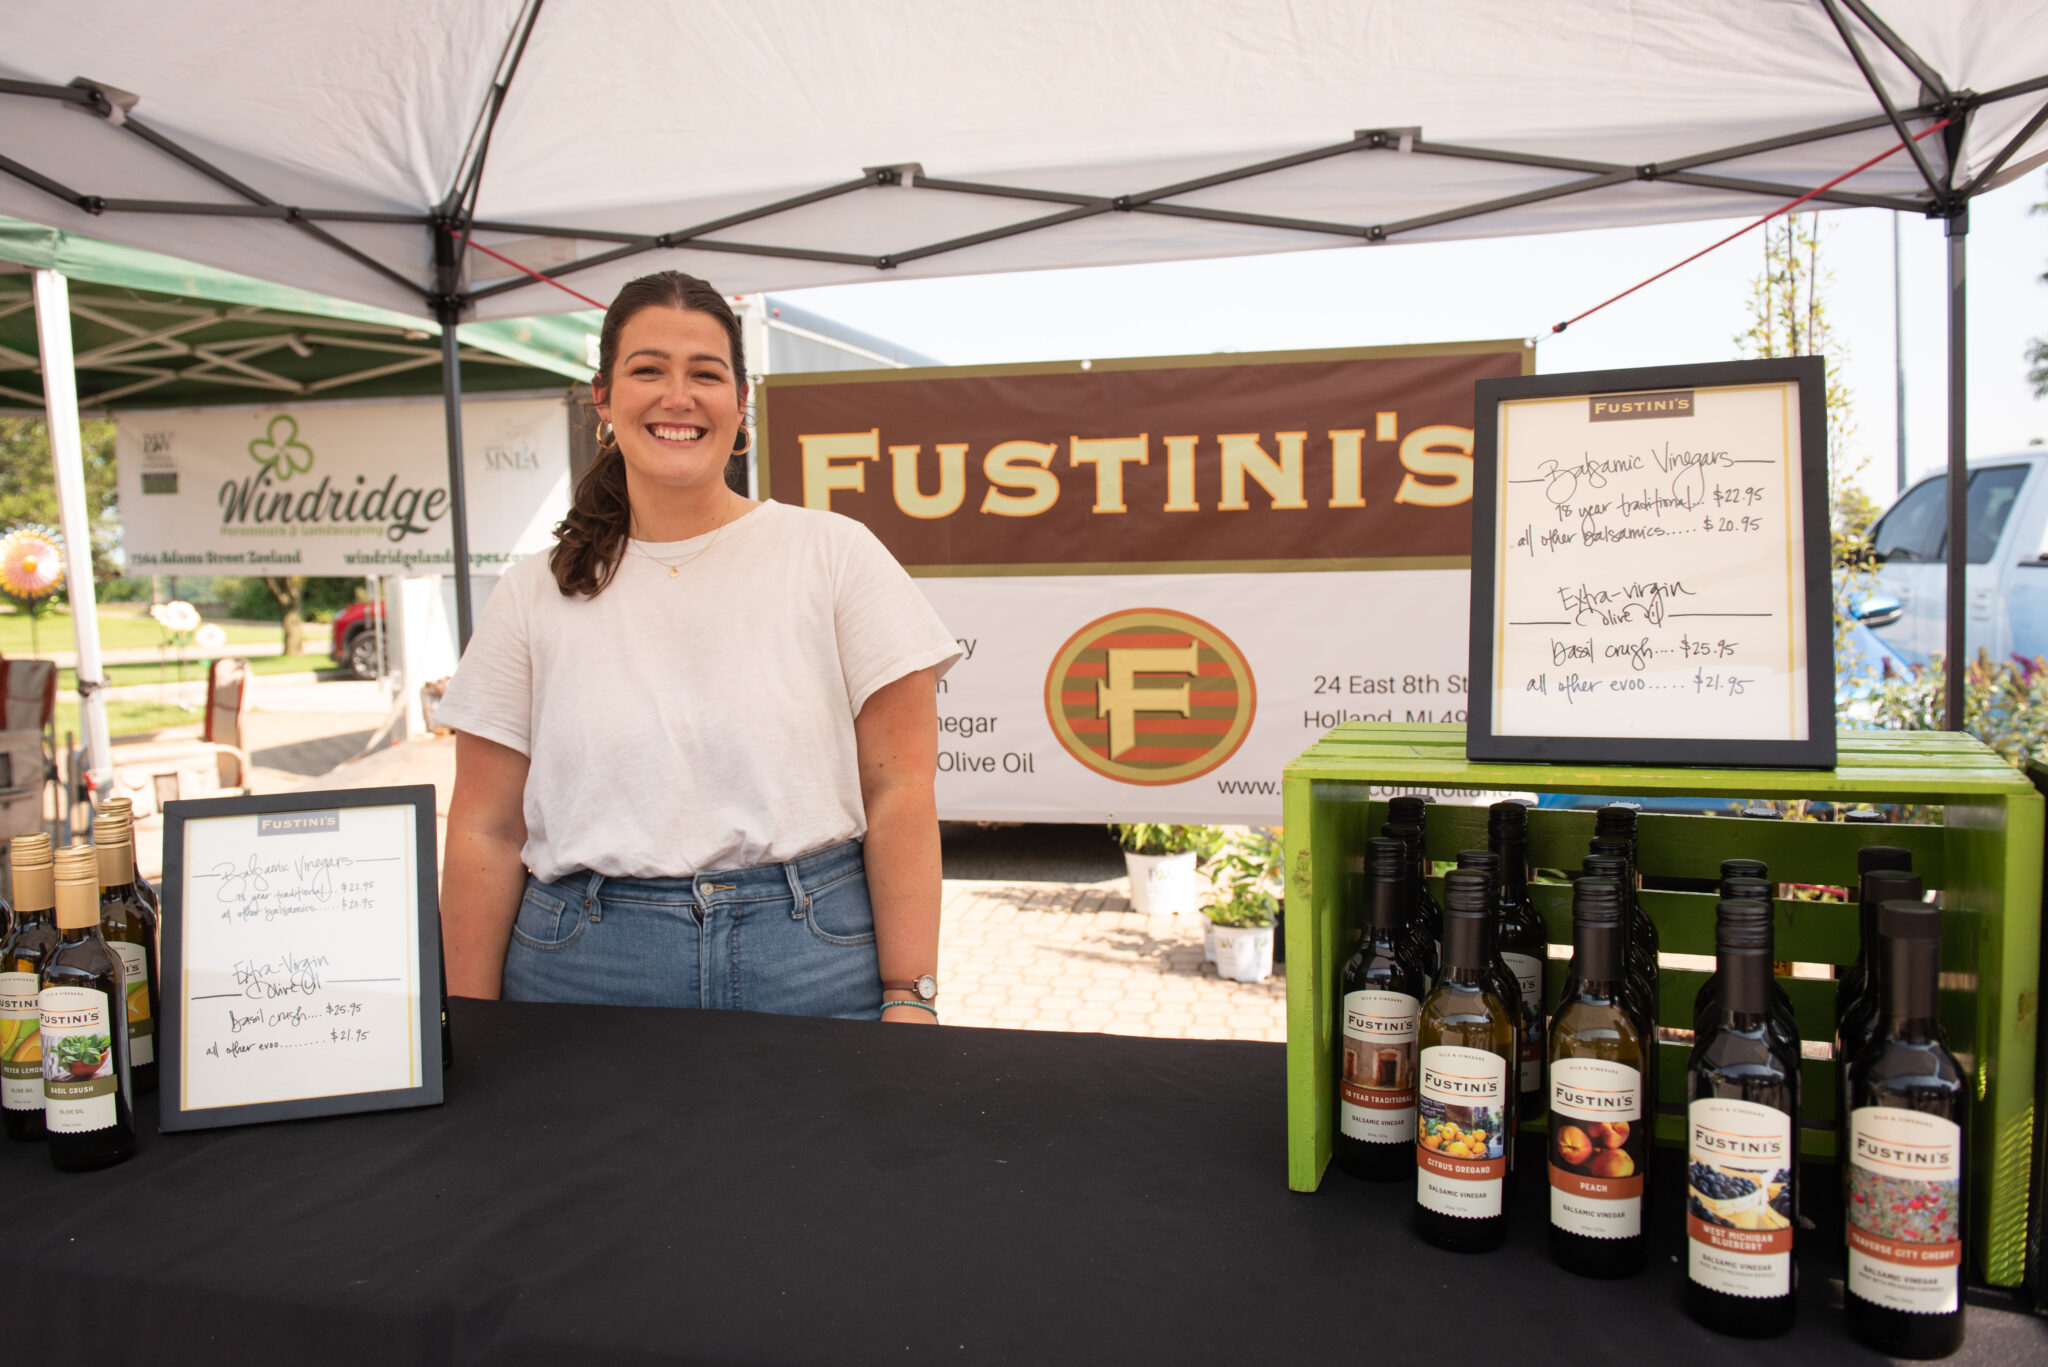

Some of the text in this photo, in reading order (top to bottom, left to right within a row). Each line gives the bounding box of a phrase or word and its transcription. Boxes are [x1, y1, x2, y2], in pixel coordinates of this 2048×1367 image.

[1593, 398, 1691, 415] FUSTINI'S
[797, 410, 1475, 519] FUSTINI'S
[1537, 441, 1735, 510] Balsamic Vinegars
[218, 463, 449, 541] Windridge
[1554, 504, 1573, 522] 18
[1578, 501, 1613, 534] year
[1713, 484, 1765, 508] $22.95
[1517, 524, 1534, 558] all
[1540, 528, 1578, 553] other
[159, 550, 202, 564] Adams
[204, 550, 244, 564] Street
[246, 549, 302, 564] Zeeland
[1679, 633, 1739, 659] $25.95
[1313, 675, 1342, 694] 24
[1349, 675, 1395, 694] East
[1402, 674, 1439, 694] 8th
[1526, 673, 1548, 696] all
[1557, 672, 1603, 705] other
[1692, 666, 1755, 697] $21.95
[1405, 710, 1432, 723] MI
[937, 751, 1035, 773] Olive Oil
[261, 816, 337, 831] FUSTINI'S
[211, 853, 354, 902] Balsamic Vinegars
[0, 999, 38, 1008] USTINI
[326, 1002, 363, 1016] $25.95
[40, 1012, 100, 1025] FUSTINI'S
[1347, 1014, 1414, 1032] FUSTINI'S
[206, 1041, 219, 1058] all
[226, 1040, 255, 1058] other
[330, 1027, 371, 1043] $21.95
[21, 1066, 43, 1074] LEMON
[50, 1085, 94, 1095] BASIL CRUSH
[1424, 1073, 1498, 1093] FUSTINI'S
[1353, 1092, 1369, 1102] YEAR
[1370, 1094, 1413, 1105] TRADITIONAL
[1556, 1087, 1633, 1107] FUSTINI'S
[1352, 1114, 1380, 1126] BALSAMIC
[1695, 1129, 1781, 1153] FUSTINI'S
[1857, 1137, 1950, 1164] FUSTINI'S
[1427, 1157, 1491, 1174] CITRUS OREGANO
[1428, 1184, 1487, 1199] BALSAMIC VINEGAR
[1579, 1181, 1608, 1193] PEACH
[1562, 1204, 1626, 1219] BALSAMIC VINEGAR
[1702, 1223, 1774, 1243] WEST MICHIGAN
[1711, 1235, 1763, 1252] BLUEBERRY
[1852, 1232, 1956, 1261] TRAVERSE CITY CHERRY
[1702, 1253, 1773, 1271] BALSAMIC VINEGAR
[1863, 1264, 1902, 1281] BALSAMIC
[1904, 1276, 1939, 1285] VINEGAR
